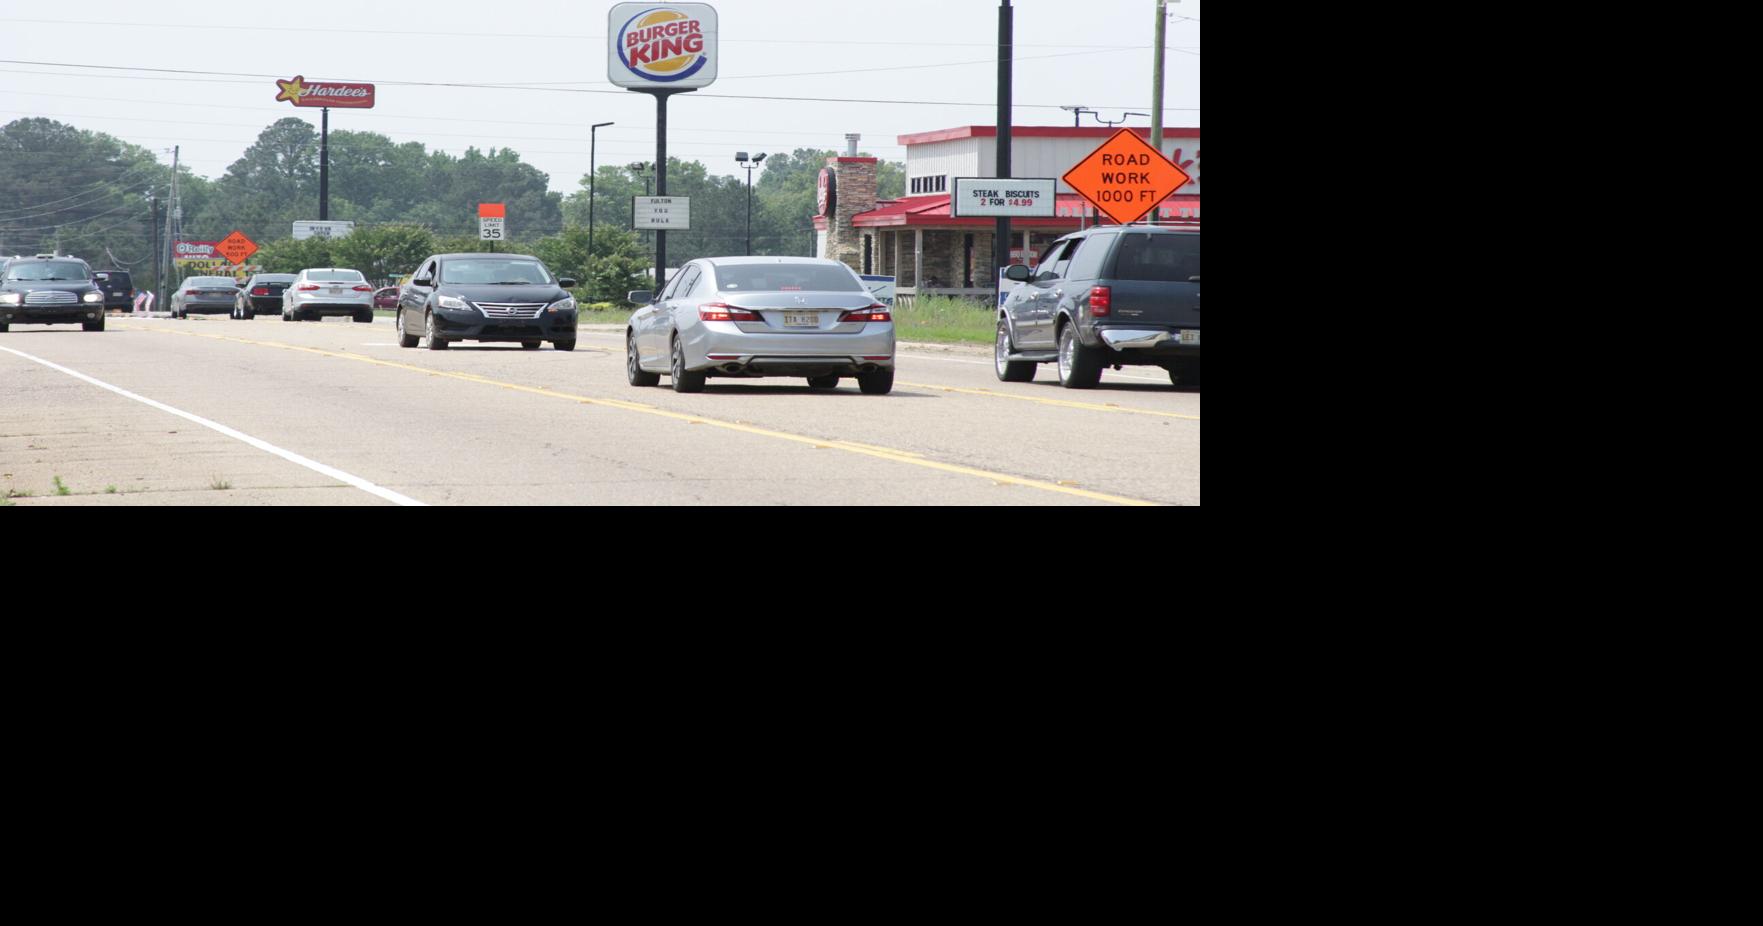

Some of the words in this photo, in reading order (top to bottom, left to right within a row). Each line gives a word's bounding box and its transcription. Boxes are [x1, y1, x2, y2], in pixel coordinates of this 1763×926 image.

[626, 20, 700, 48] BURGER
[629, 33, 703, 68] KING
[298, 85, 369, 97] Hardee's
[1102, 153, 1151, 166] ROAD
[1101, 172, 1151, 185] WORK
[972, 189, 999, 198] STEAK
[1005, 190, 1040, 198] BISCUITS
[1096, 190, 1134, 202] 1000
[1139, 190, 1157, 203] FT
[980, 198, 986, 206] 2
[989, 198, 1005, 206] FOR
[1008, 198, 1033, 207] $4.99
[482, 228, 501, 239] 35
[176, 242, 215, 255] O'Reilly
